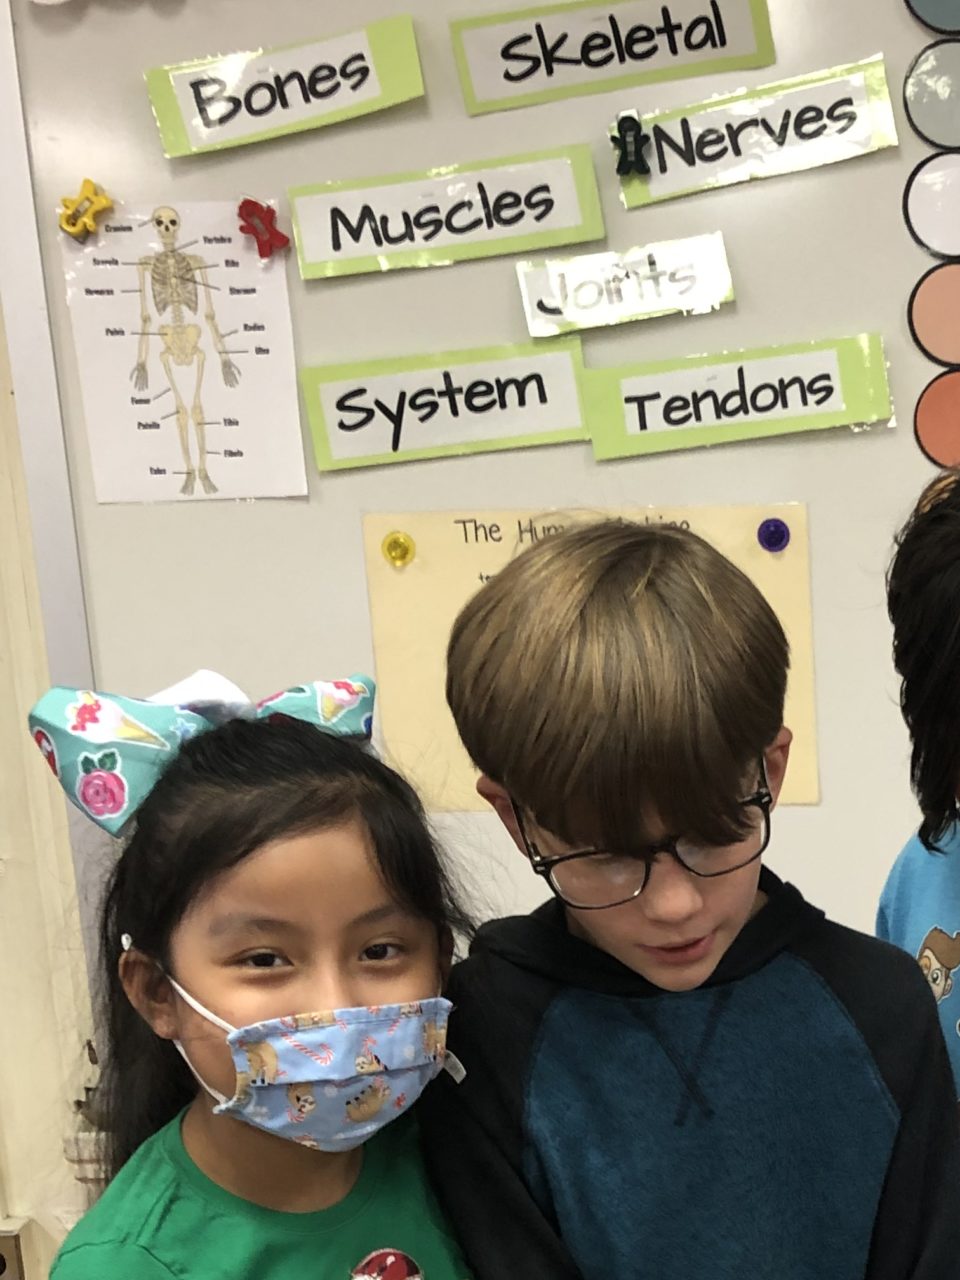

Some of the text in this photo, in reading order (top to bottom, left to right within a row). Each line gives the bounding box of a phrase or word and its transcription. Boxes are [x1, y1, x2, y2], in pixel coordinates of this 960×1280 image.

[500, 0, 728, 83] Skeletal
[189, 52, 370, 129] Bones
[652, 97, 858, 174] Nerves
[330, 182, 554, 252] Muscles
[335, 370, 548, 451] System
[624, 366, 834, 431] Tendons
[454, 519, 566, 544] The Hum
